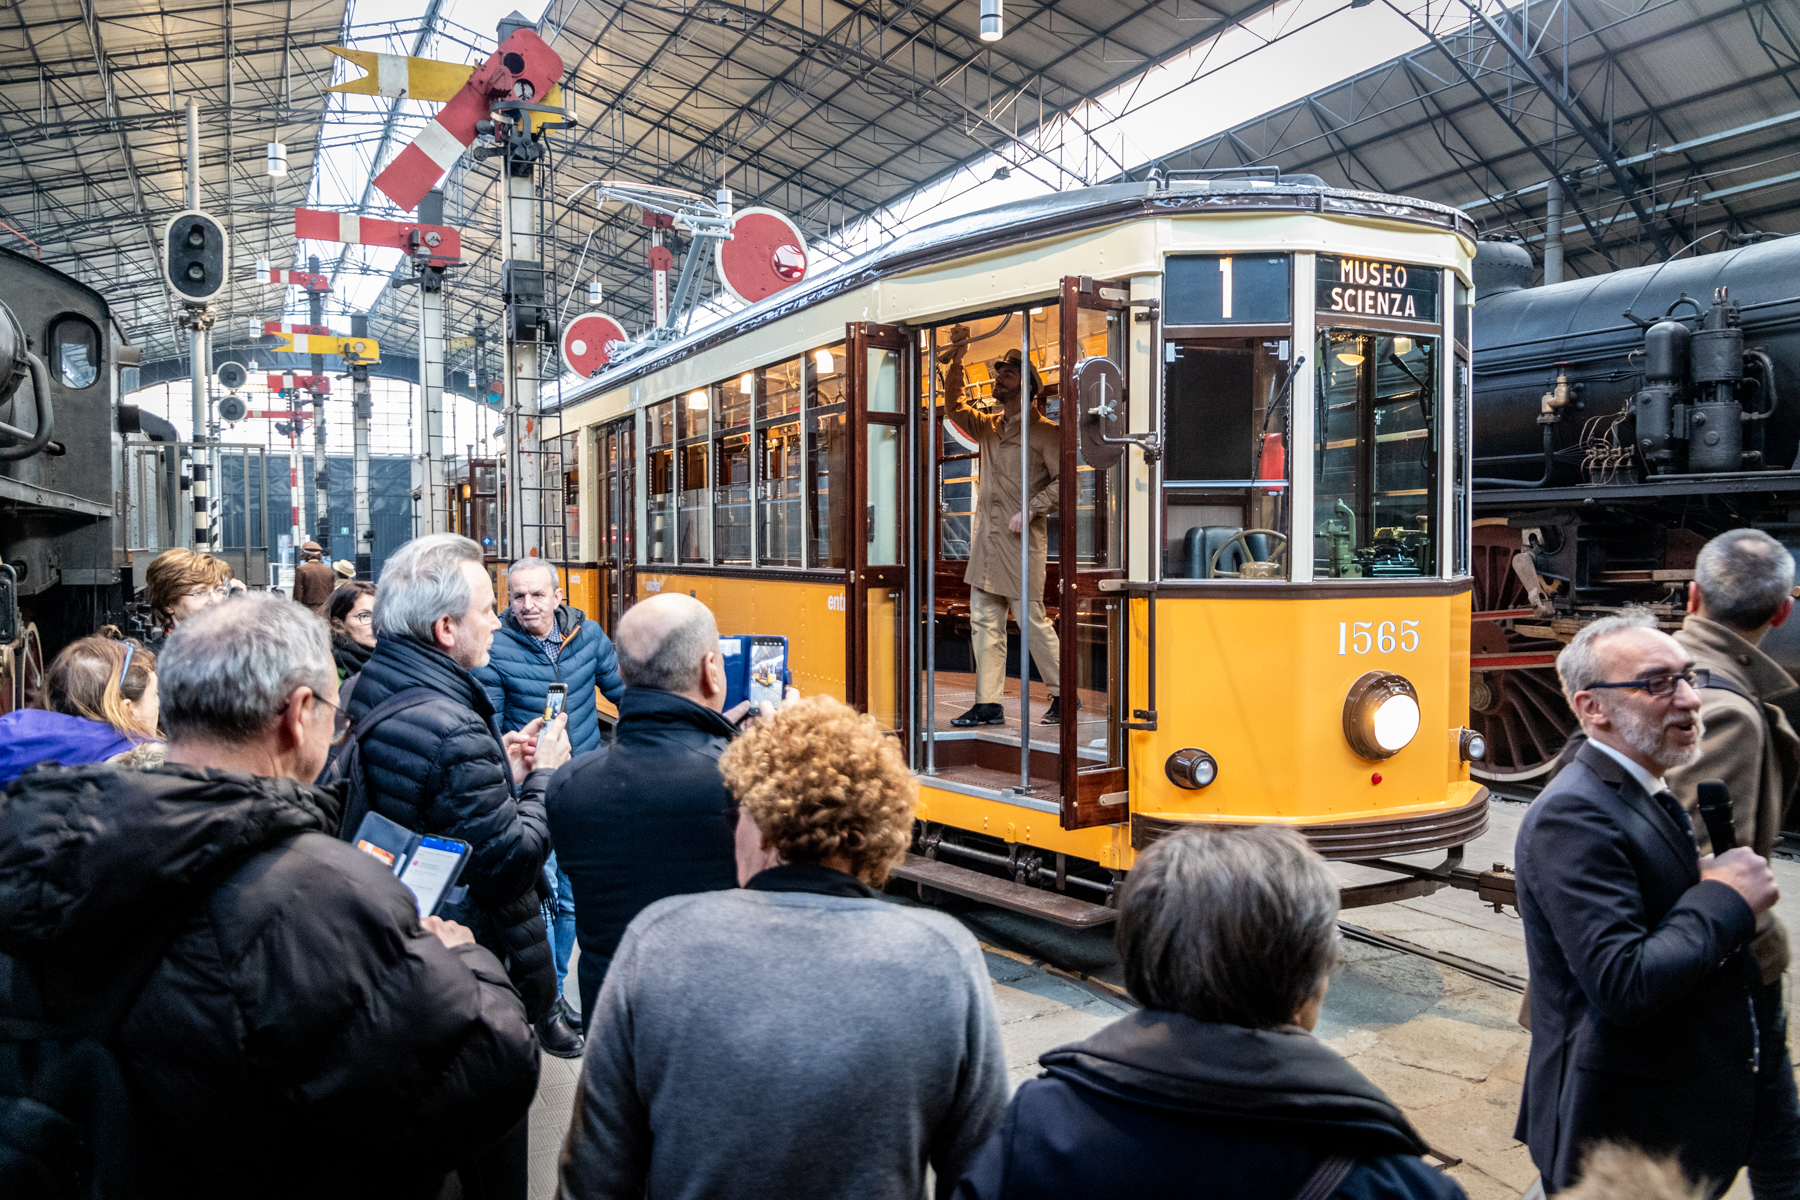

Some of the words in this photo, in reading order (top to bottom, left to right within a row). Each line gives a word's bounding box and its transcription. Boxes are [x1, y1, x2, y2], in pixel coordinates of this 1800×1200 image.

[1219, 256, 1233, 319] 1
[1340, 258, 1408, 288] MUSEO
[1330, 286, 1416, 318] SCIENZA
[646, 578, 661, 592] uscita
[827, 592, 846, 612] entr
[1337, 619, 1420, 656] 1565
